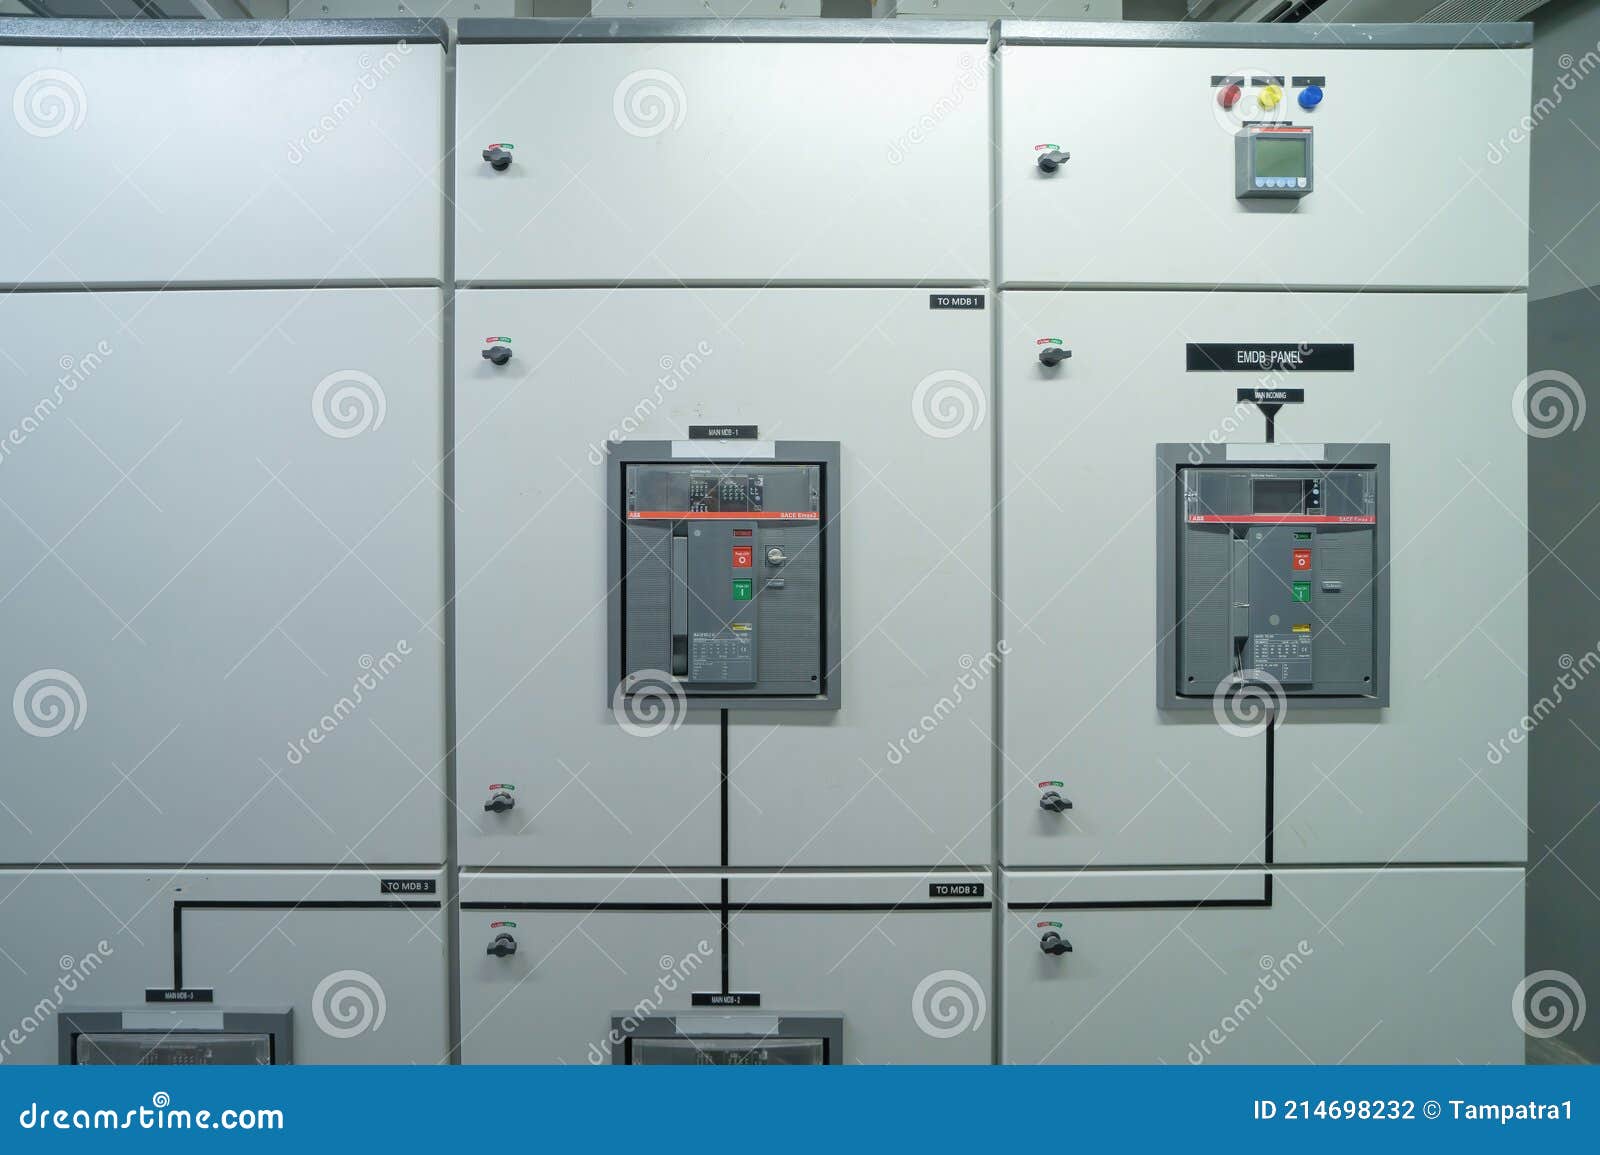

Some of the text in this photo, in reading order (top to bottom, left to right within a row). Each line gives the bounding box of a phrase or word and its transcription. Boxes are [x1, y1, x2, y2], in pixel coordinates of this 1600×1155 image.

[937, 297, 950, 306] TO
[951, 297, 972, 306] MDB
[1237, 350, 1304, 363] EMDB PANEL
[387, 882, 429, 890] TO MDB 3
[936, 885, 978, 894] TO MDB 2
